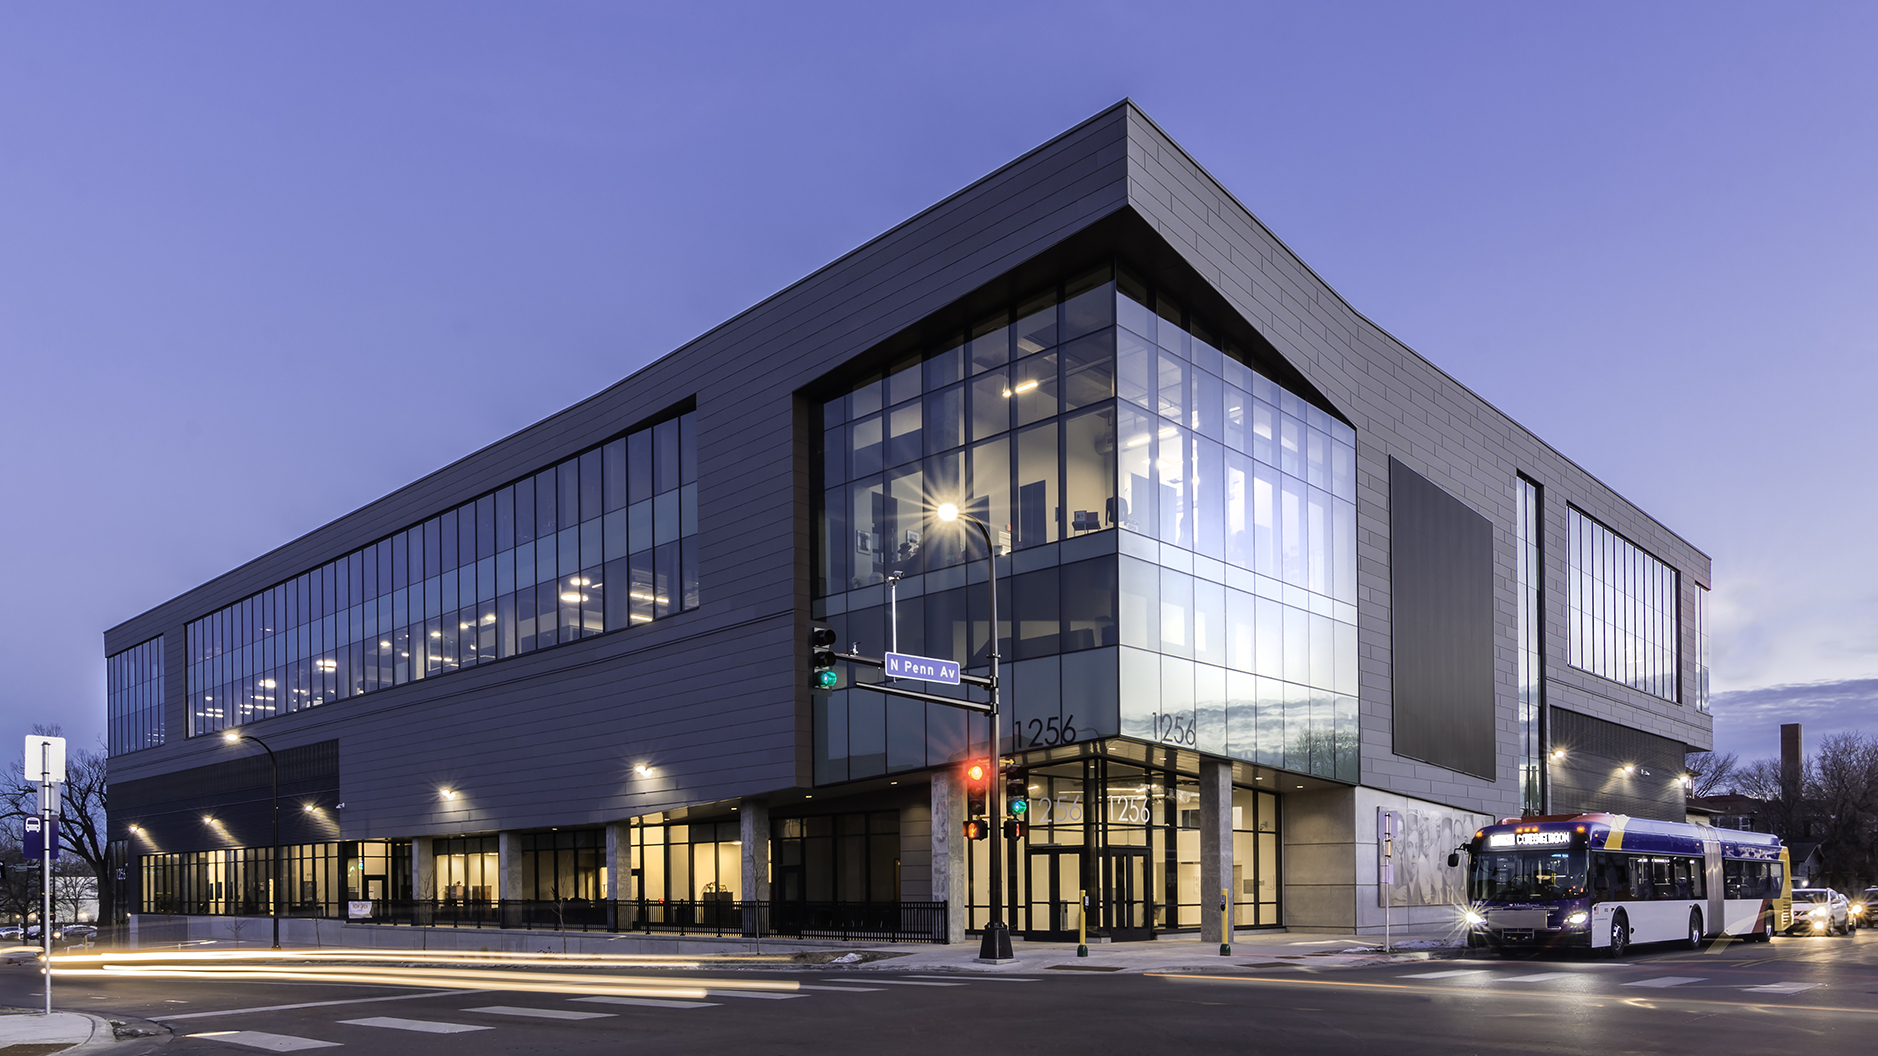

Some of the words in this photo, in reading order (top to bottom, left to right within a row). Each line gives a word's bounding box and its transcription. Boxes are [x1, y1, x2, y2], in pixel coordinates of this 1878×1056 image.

[890, 658, 899, 671] N
[904, 660, 934, 676] Penn
[940, 665, 955, 679] Av
[1015, 714, 1076, 749] 1256
[1152, 711, 1196, 746] 1256
[1026, 795, 1082, 824] 1256
[1108, 794, 1150, 823] 1256
